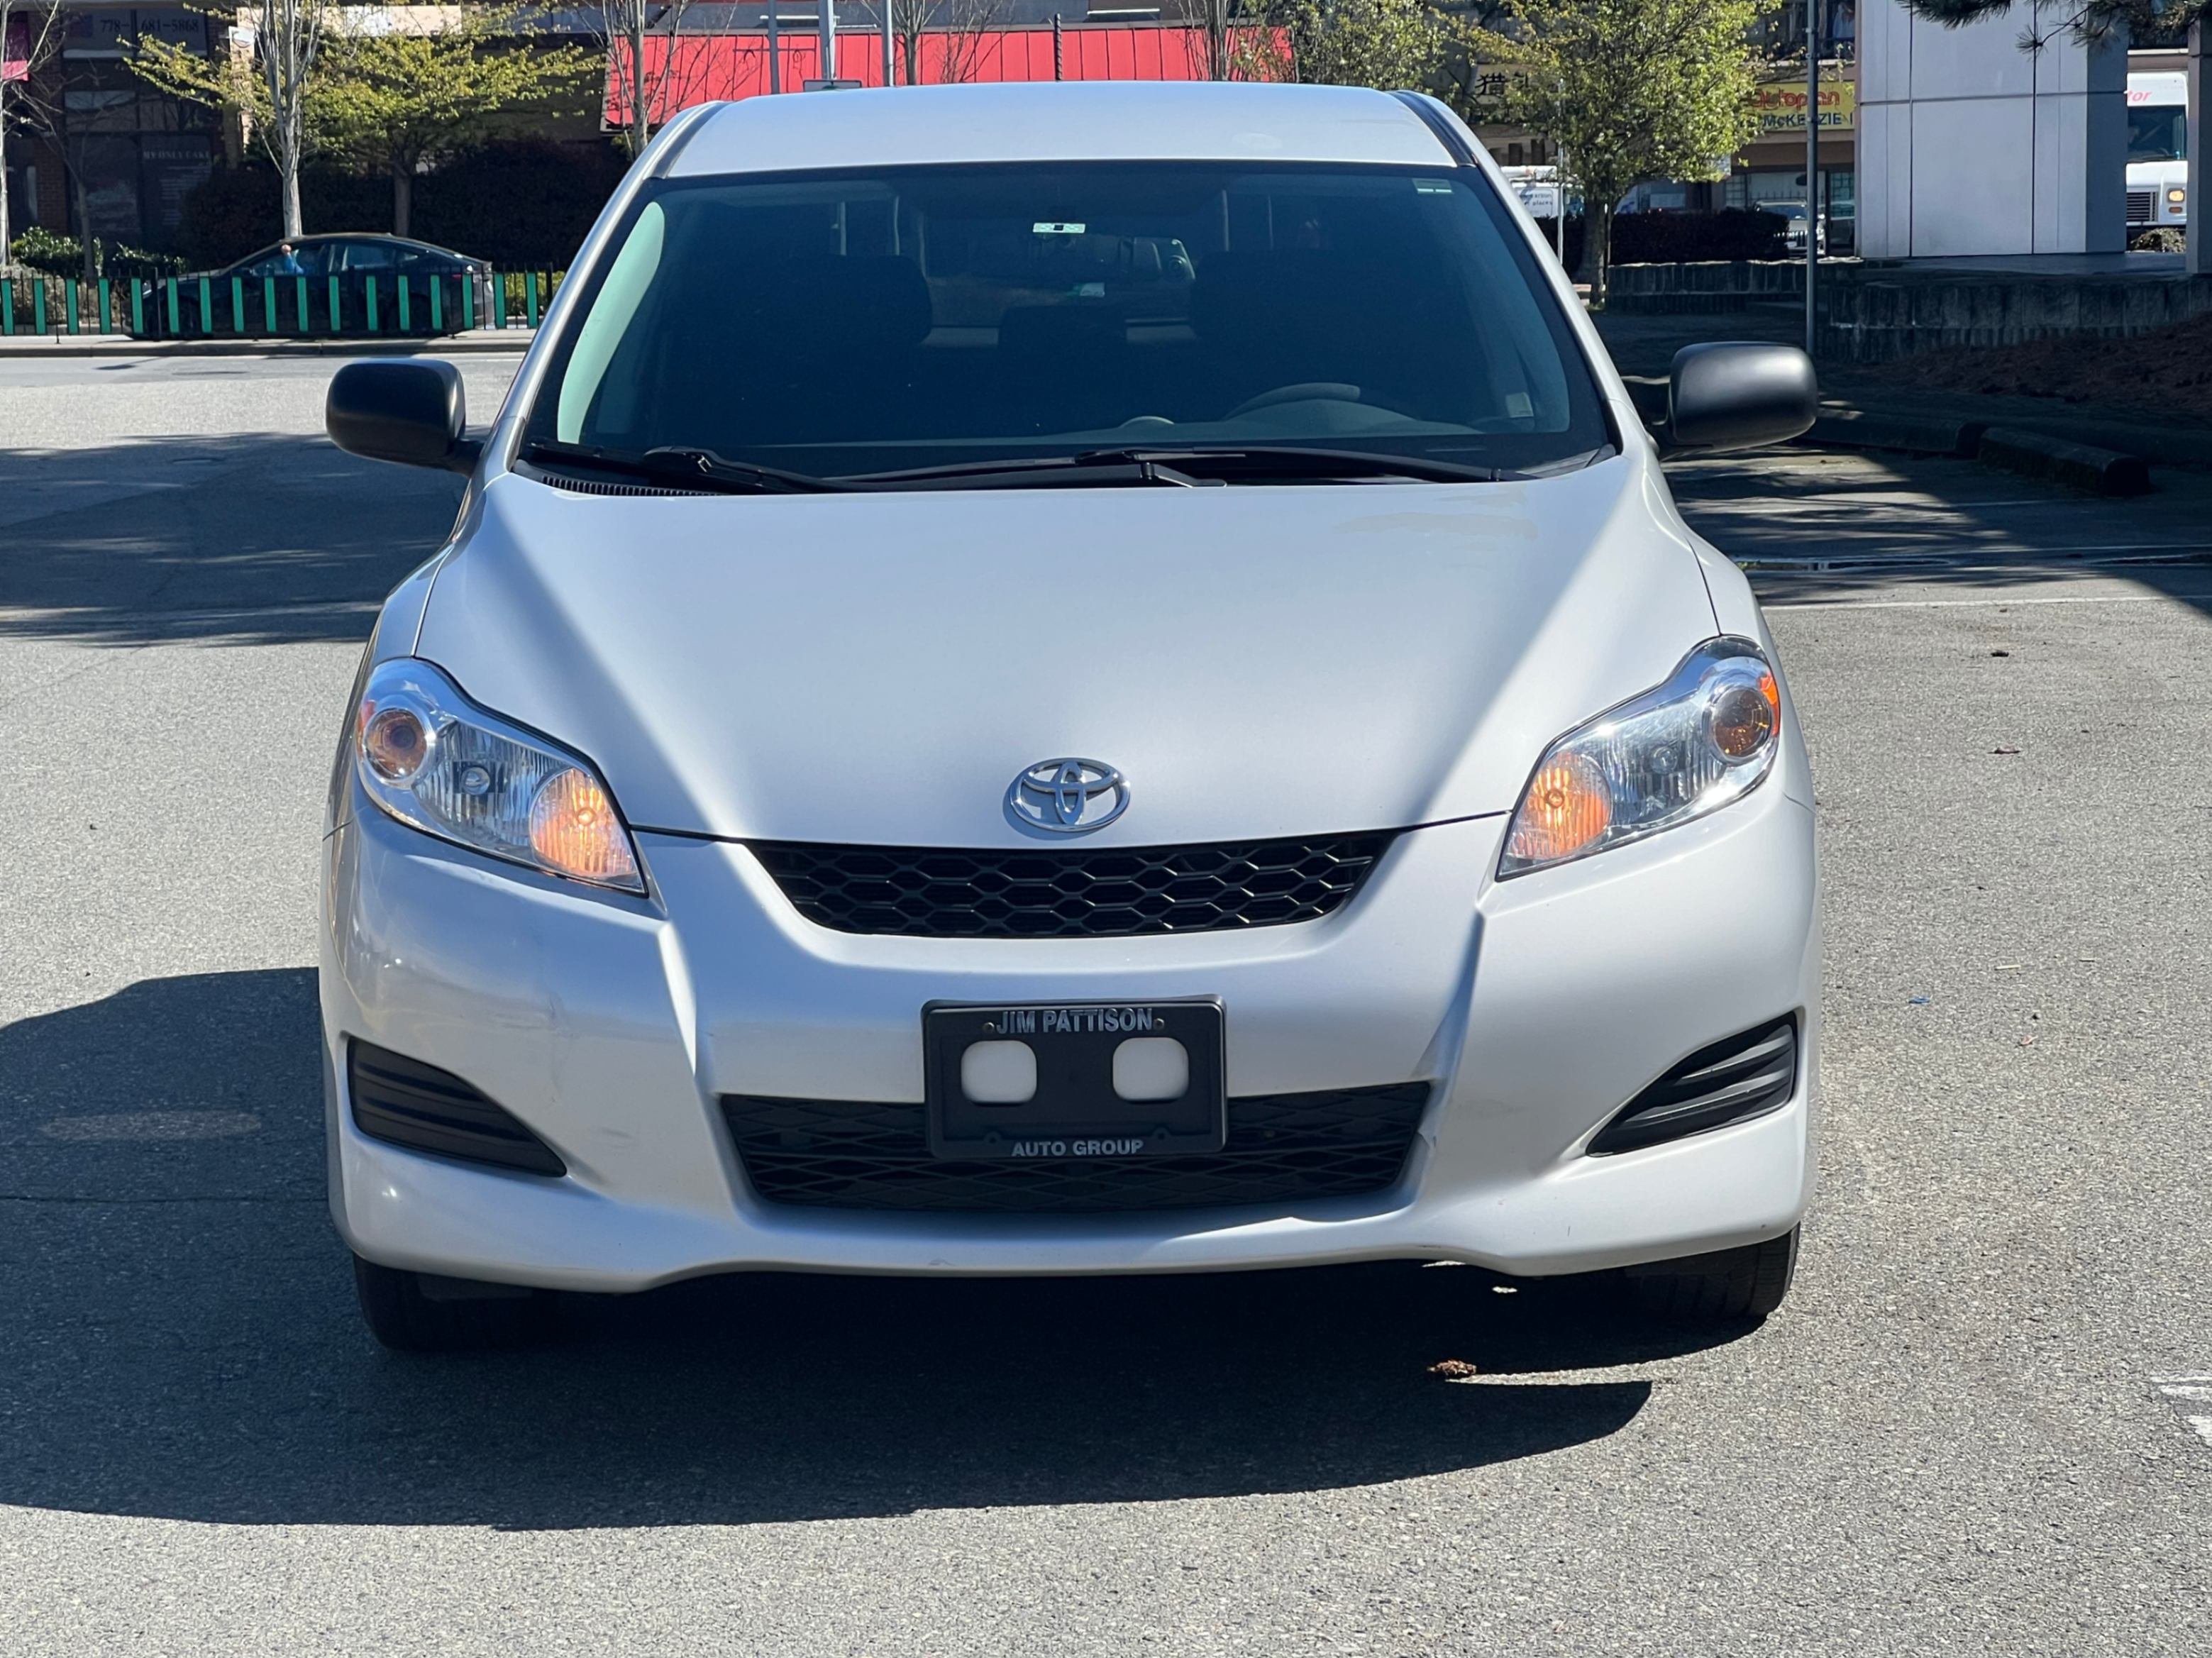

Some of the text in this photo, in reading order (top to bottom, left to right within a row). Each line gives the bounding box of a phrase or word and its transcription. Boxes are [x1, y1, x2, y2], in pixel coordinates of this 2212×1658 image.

[1764, 113, 1842, 128] McKEZIE
[158, 150, 183, 159] ONLY
[996, 1007, 1153, 1034] JIM PATTISON
[1011, 1139, 1144, 1157] AUTO GROUP
